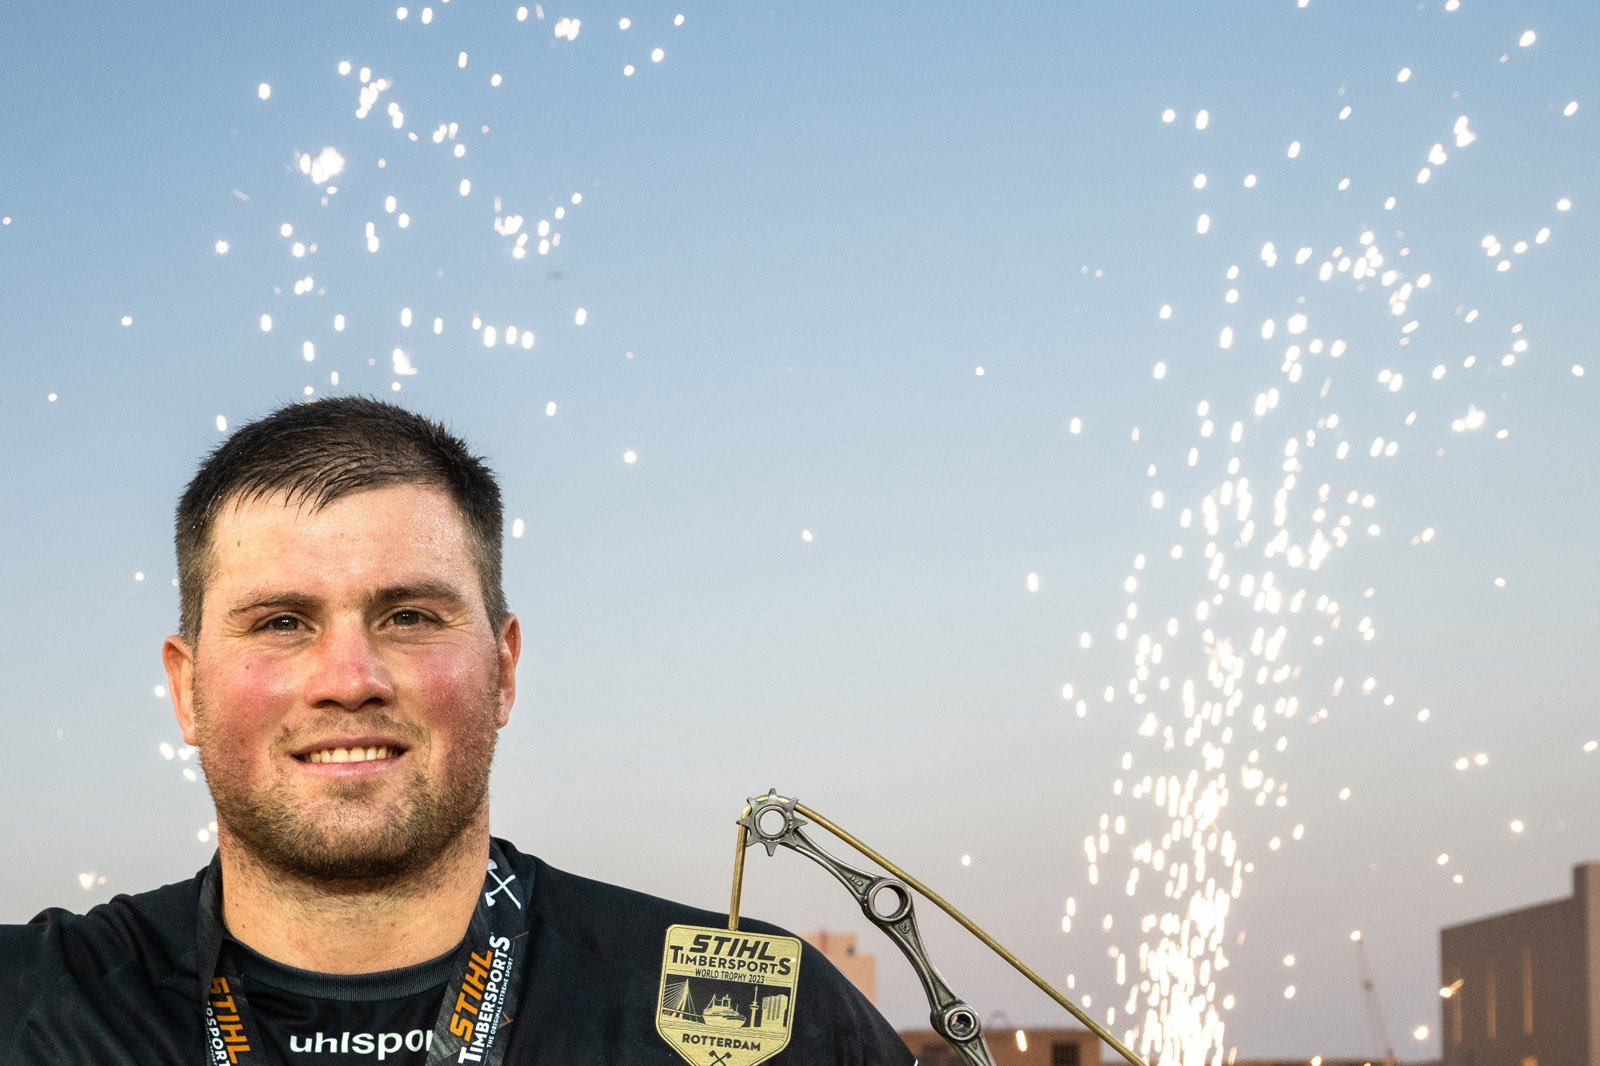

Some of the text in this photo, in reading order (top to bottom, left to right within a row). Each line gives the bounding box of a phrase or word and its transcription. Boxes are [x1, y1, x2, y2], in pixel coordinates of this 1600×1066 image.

[670, 945, 792, 975] TIMBERSPORTS
[689, 934, 776, 961] STIHL
[695, 968, 765, 984] WORLD TROPHY 2023
[450, 950, 493, 1042] STIHL
[458, 936, 510, 1064] TIMBERSPORTS
[209, 977, 250, 1064] STIHL
[682, 1033, 760, 1051] ROTTERDAM
